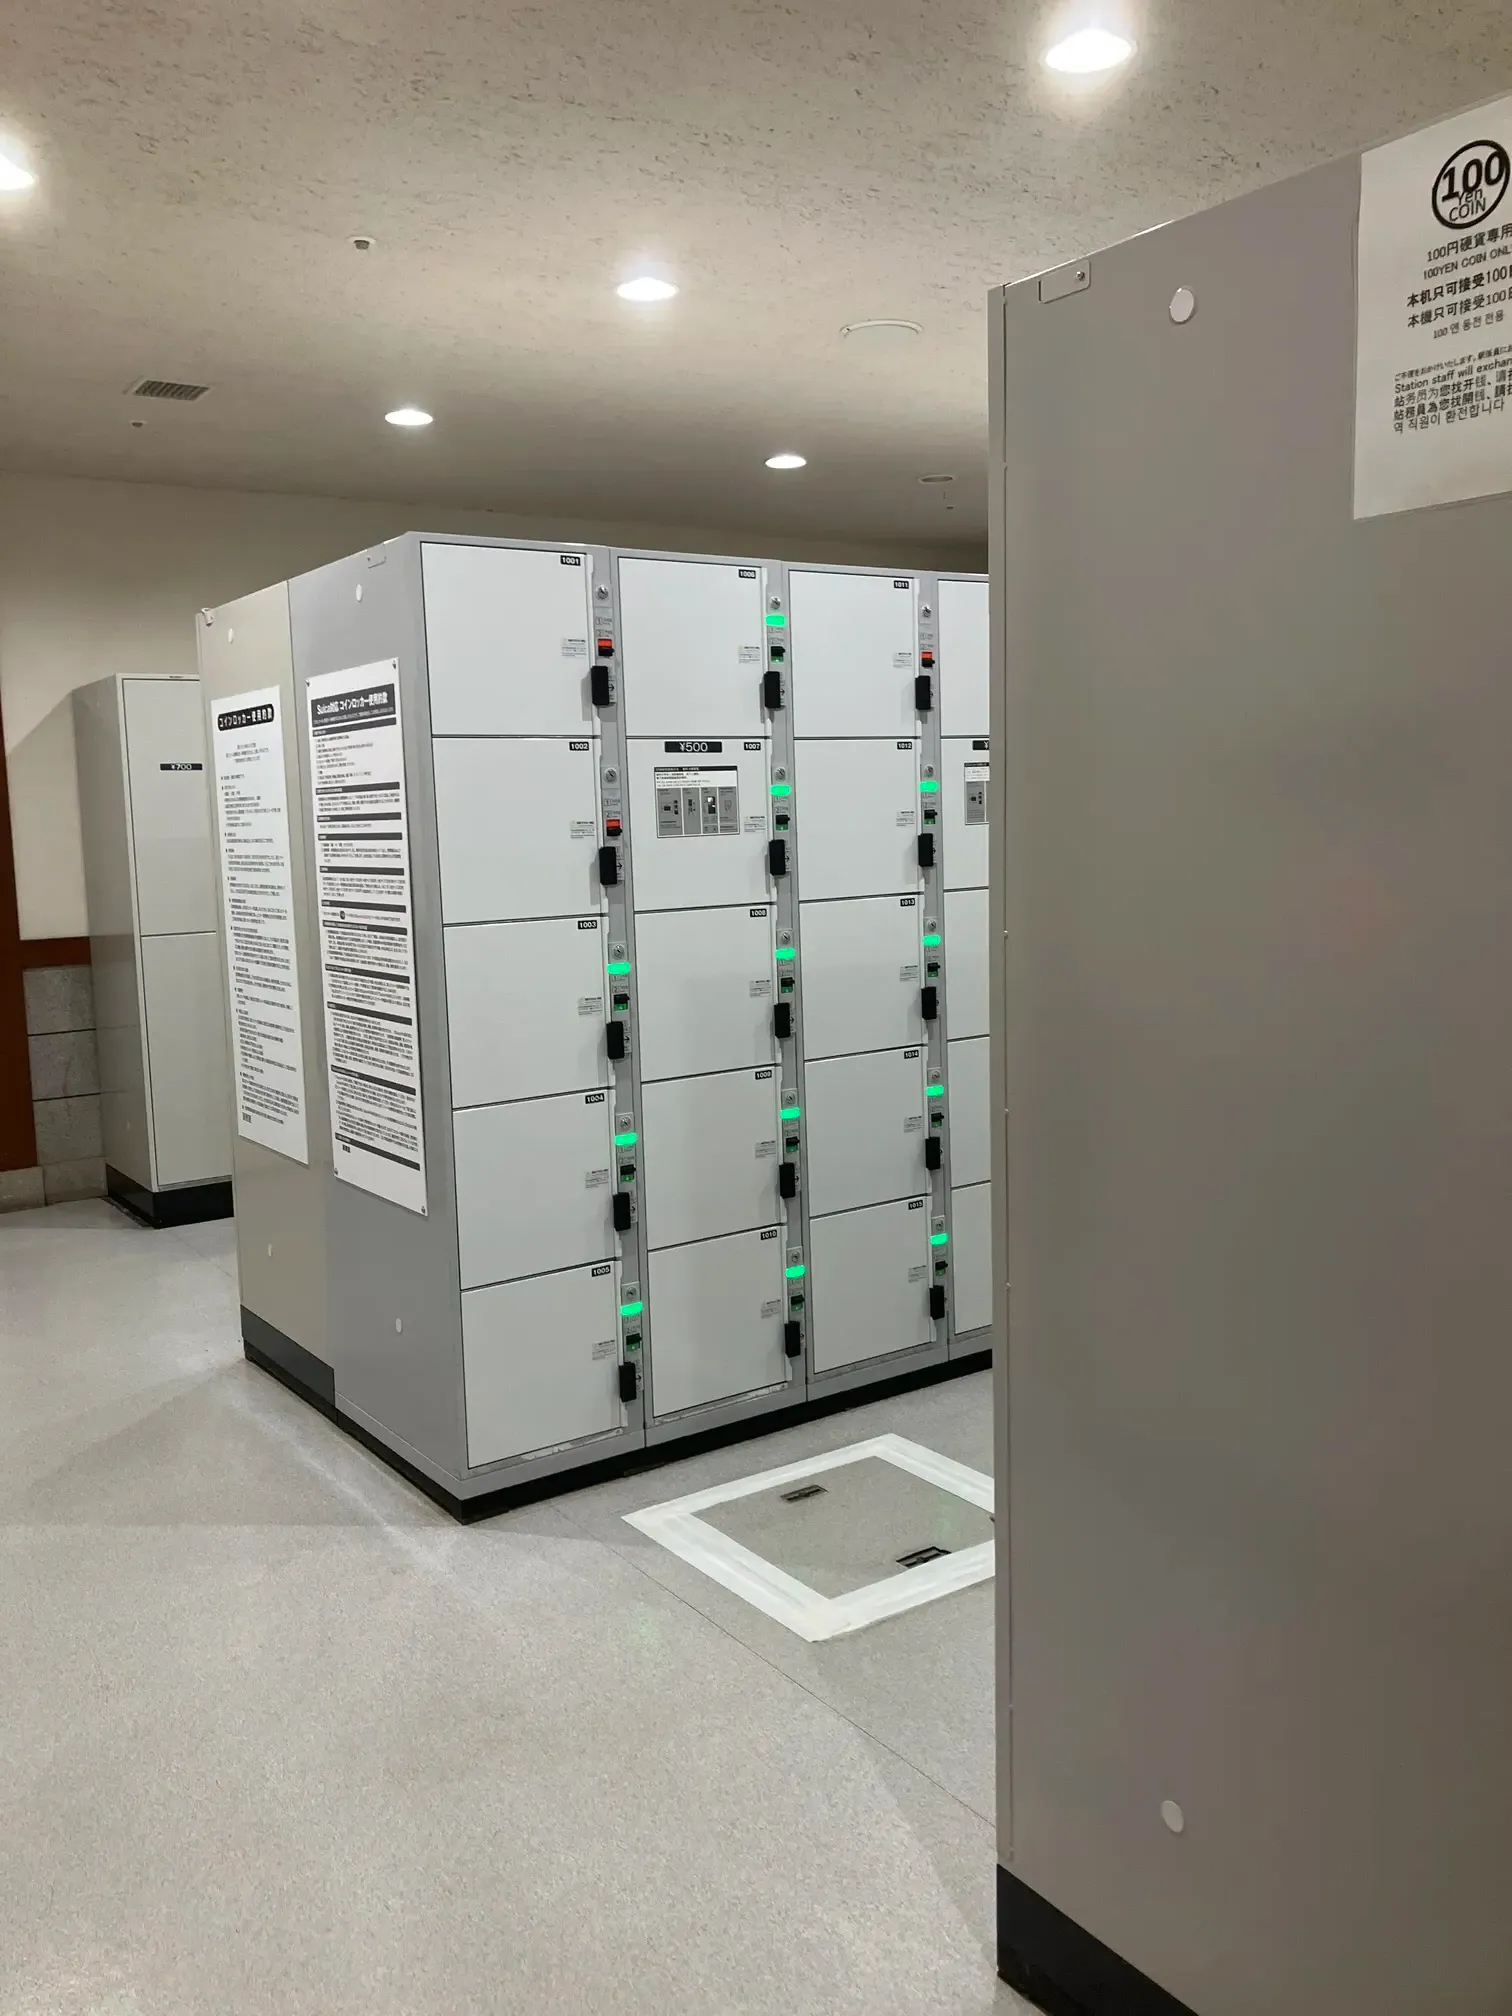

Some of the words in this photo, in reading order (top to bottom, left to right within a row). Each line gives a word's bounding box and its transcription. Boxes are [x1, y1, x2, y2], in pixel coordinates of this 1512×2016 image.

[1441, 150, 1505, 203] 100
[1449, 197, 1486, 222] COIN
[1424, 261, 1459, 280] 100YEN
[1461, 251, 1487, 268] COIN
[1489, 244, 1512, 259] ONL
[1433, 327, 1448, 339] 100
[1394, 379, 1429, 394] Station
[1431, 369, 1456, 385] staff
[1457, 364, 1473, 378] will
[562, 556, 579, 565] 1001
[571, 742, 588, 750] 1002
[679, 742, 708, 752] ¥500
[579, 920, 597, 928] 1003
[762, 1230, 777, 1239] 1010
[593, 1266, 610, 1275] 1005
